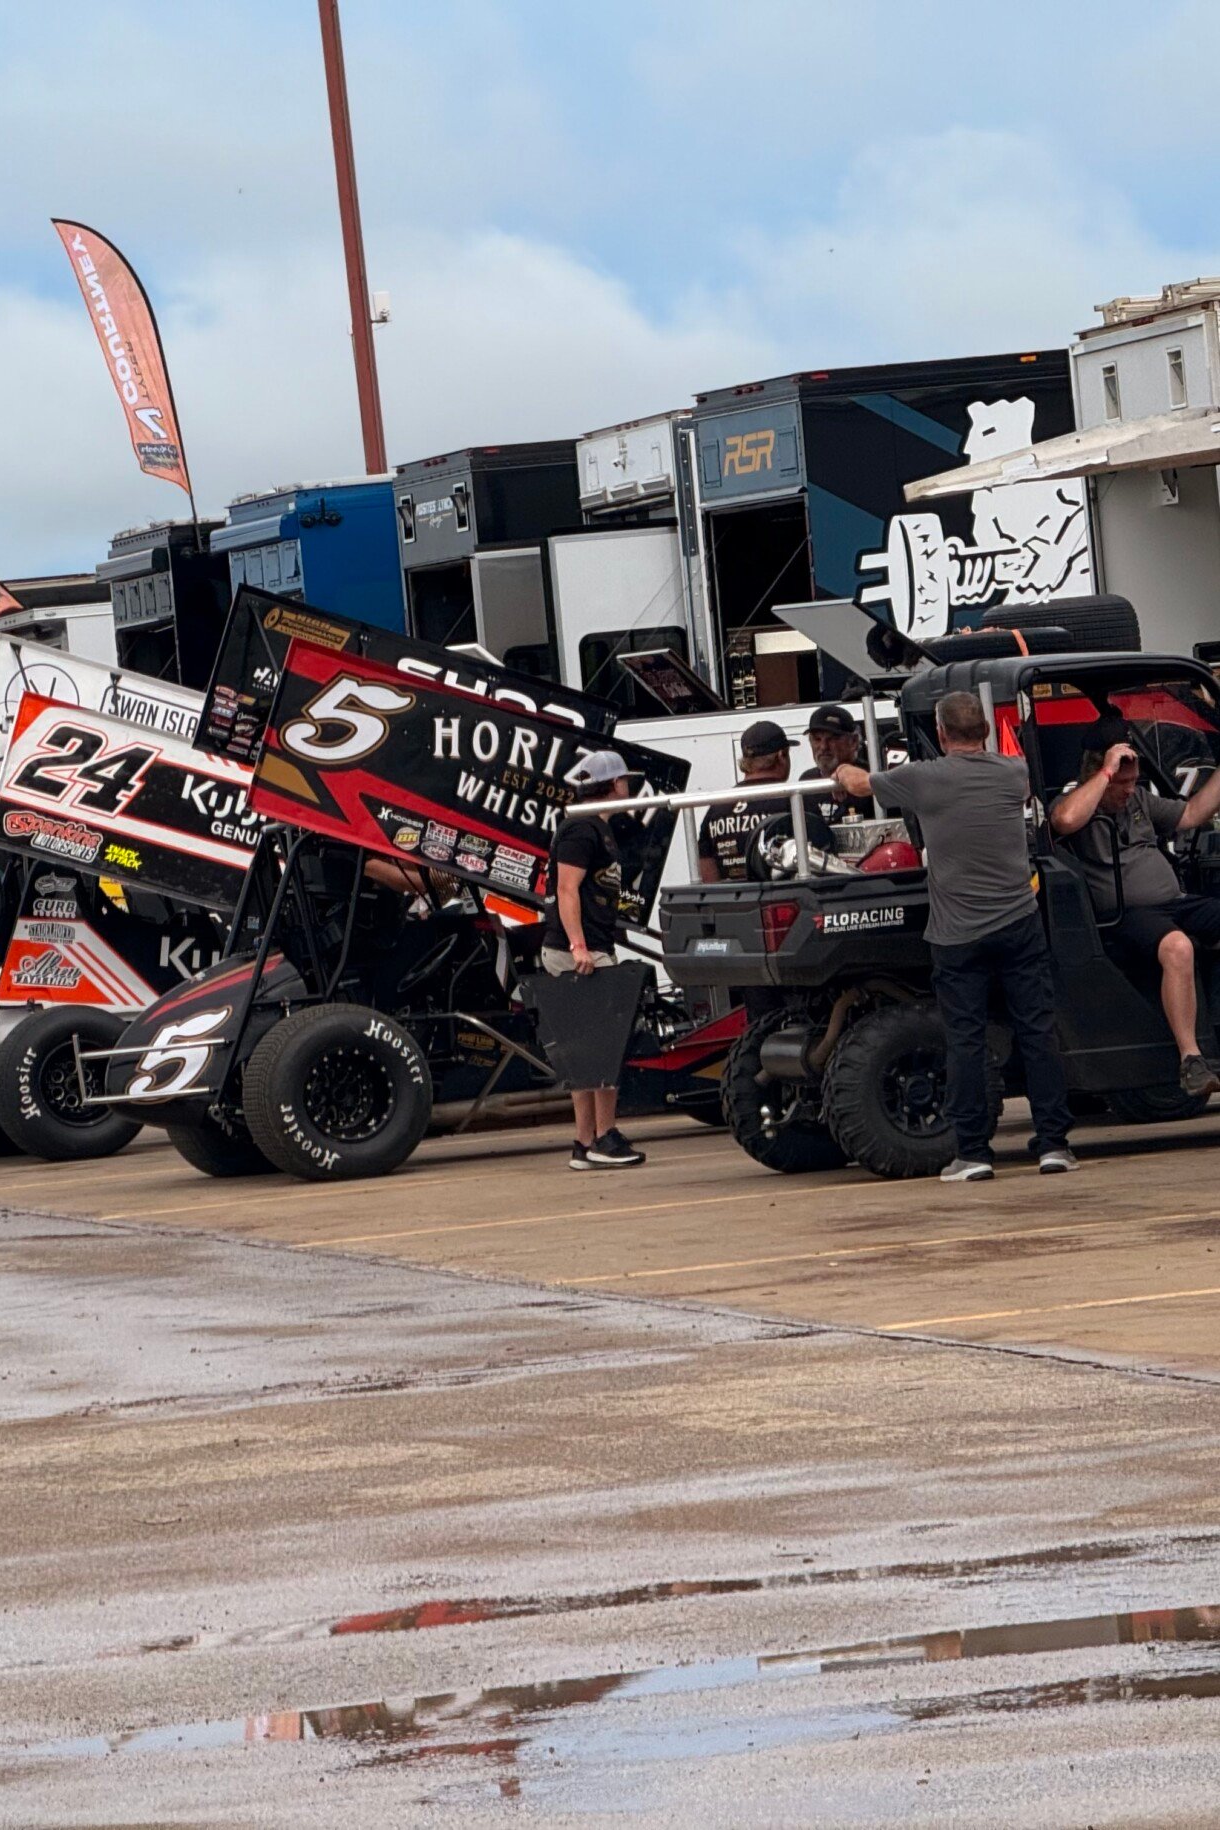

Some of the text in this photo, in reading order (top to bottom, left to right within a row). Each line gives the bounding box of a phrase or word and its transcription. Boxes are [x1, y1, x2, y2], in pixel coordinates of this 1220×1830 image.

[723, 429, 775, 477] RSR
[107, 694, 158, 729] SWAN
[281, 672, 415, 763] 5
[6, 719, 163, 818] 24
[501, 769, 576, 803] EST 2022
[36, 833, 97, 862] MOTORSPORTS
[103, 851, 143, 871] ATTACK
[34, 900, 76, 913] CURB
[823, 906, 905, 929] FLORACING
[127, 1006, 232, 1103] 5
[363, 1019, 424, 1084] Hoosier
[17, 1047, 41, 1121] Hoosier
[280, 1103, 341, 1170] Hoosier
